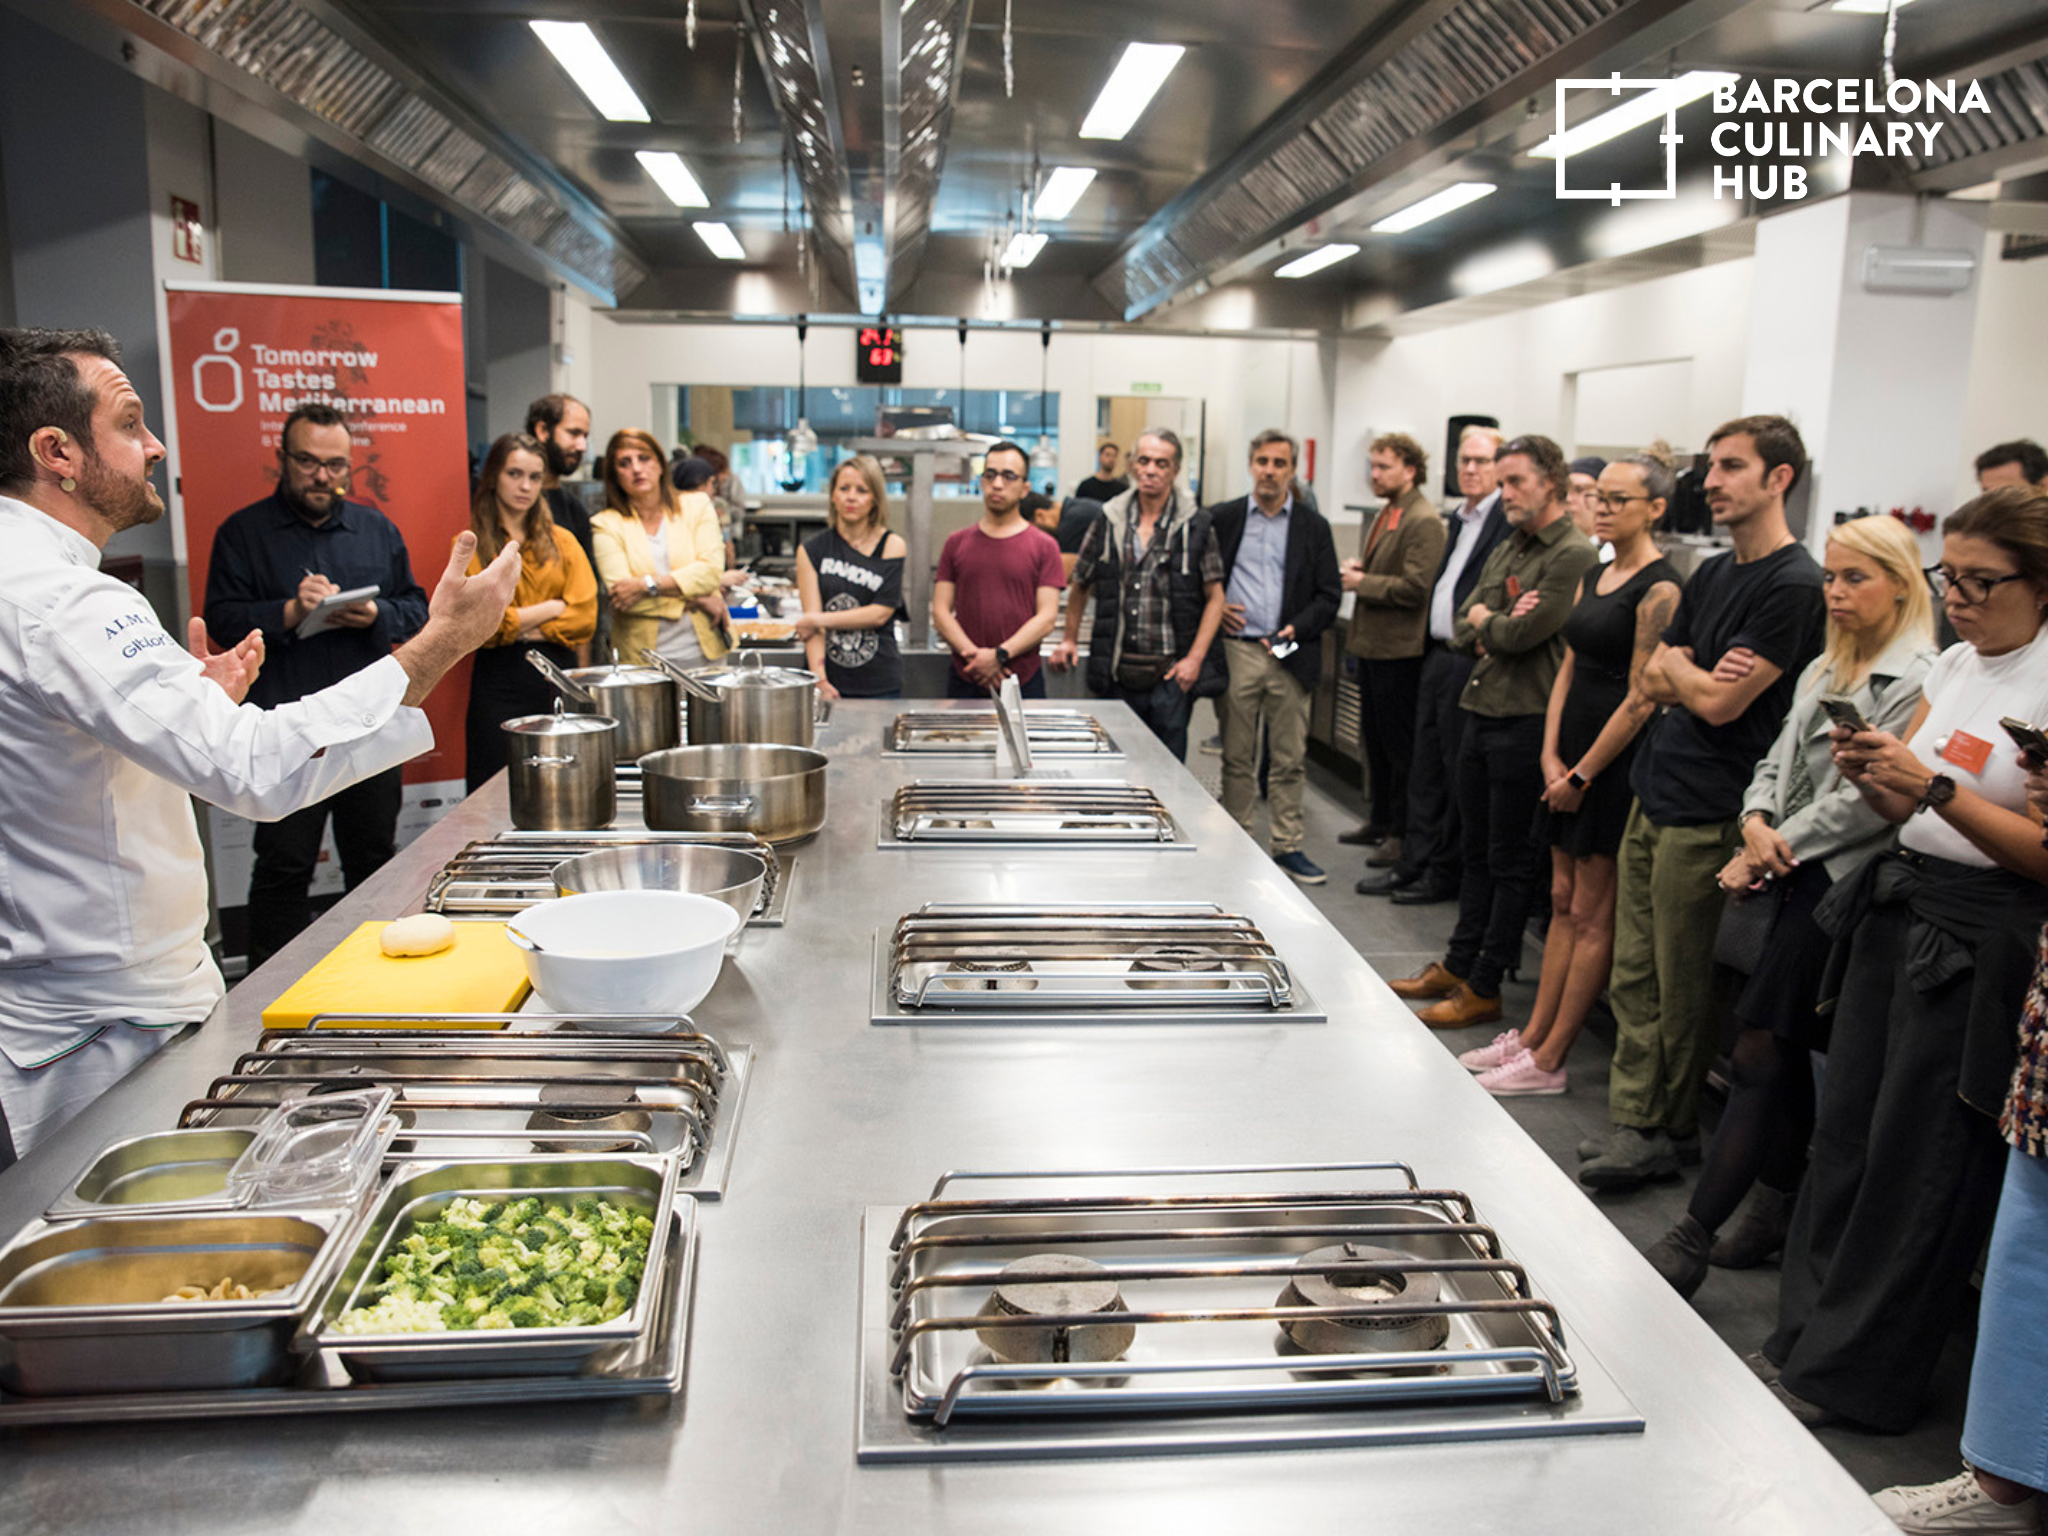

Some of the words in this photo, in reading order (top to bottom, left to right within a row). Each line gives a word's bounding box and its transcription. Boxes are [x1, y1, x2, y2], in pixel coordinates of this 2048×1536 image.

[251, 344, 378, 367] Tomorrow
[252, 368, 336, 390] Tastes
[258, 392, 445, 414] Mediterranean
[348, 421, 407, 432] onference
